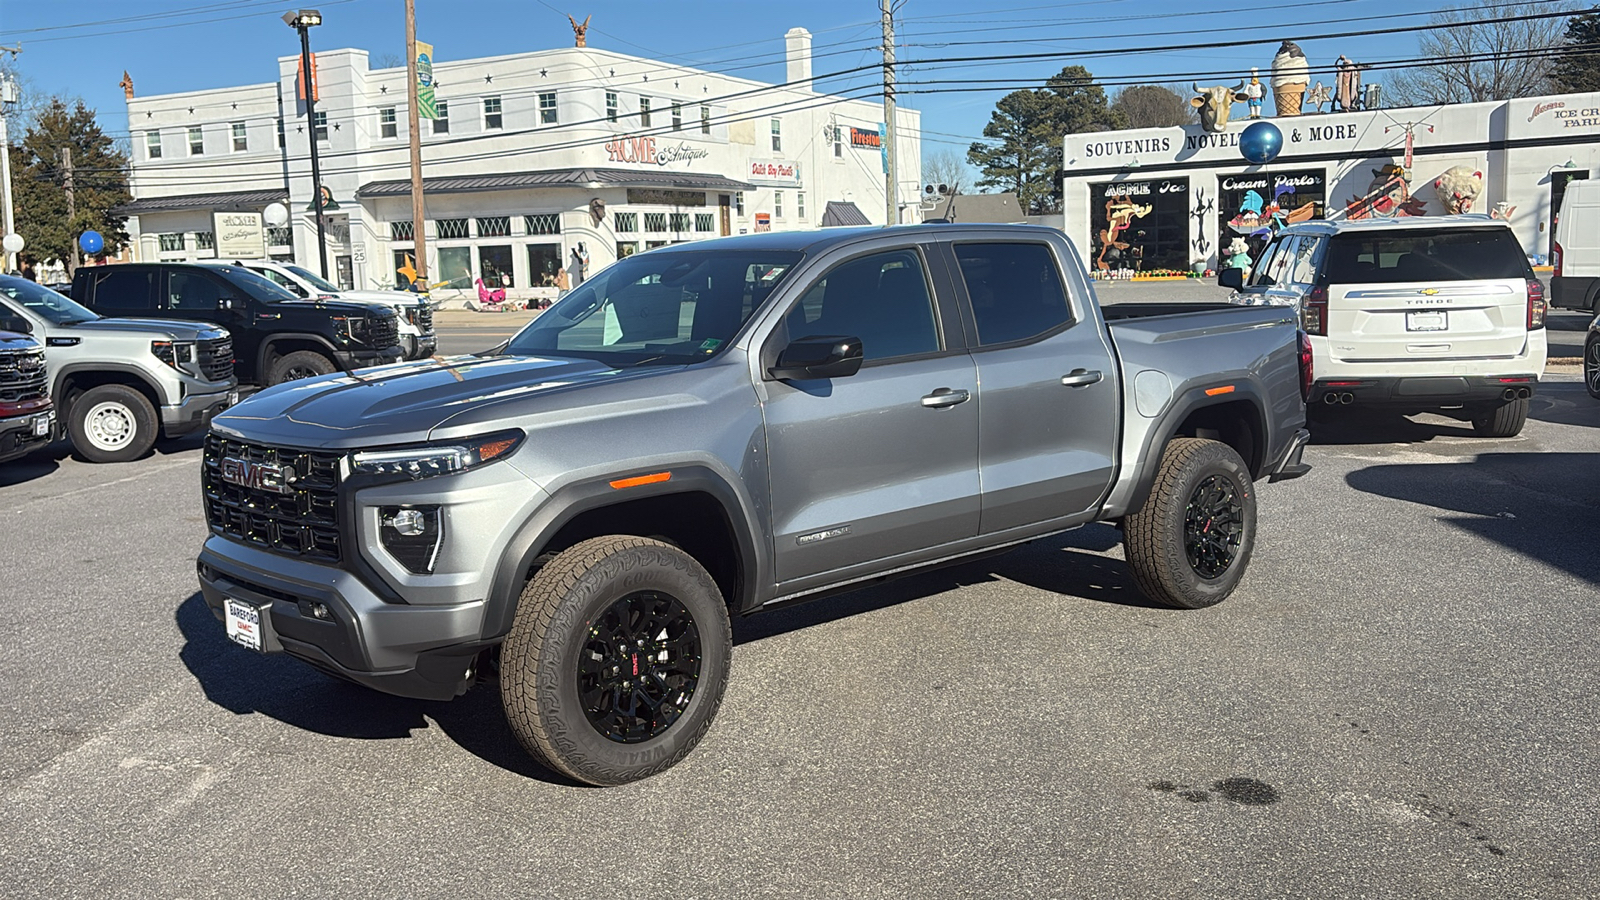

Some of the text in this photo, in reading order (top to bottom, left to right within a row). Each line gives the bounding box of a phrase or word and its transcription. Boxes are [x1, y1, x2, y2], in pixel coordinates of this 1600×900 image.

[1554, 110, 1577, 119] ICE
[850, 128, 880, 146] Fireston
[1085, 124, 1357, 157] SOUVENIRS NOVEL & MORE
[604, 134, 657, 164] ACME
[767, 164, 777, 178] Boy
[1104, 180, 1187, 197] ACME Ice
[1222, 174, 1323, 190] Cream Parlor
[222, 215, 257, 227] ACME
[354, 252, 365, 261] 25
[221, 456, 284, 494] GMC
